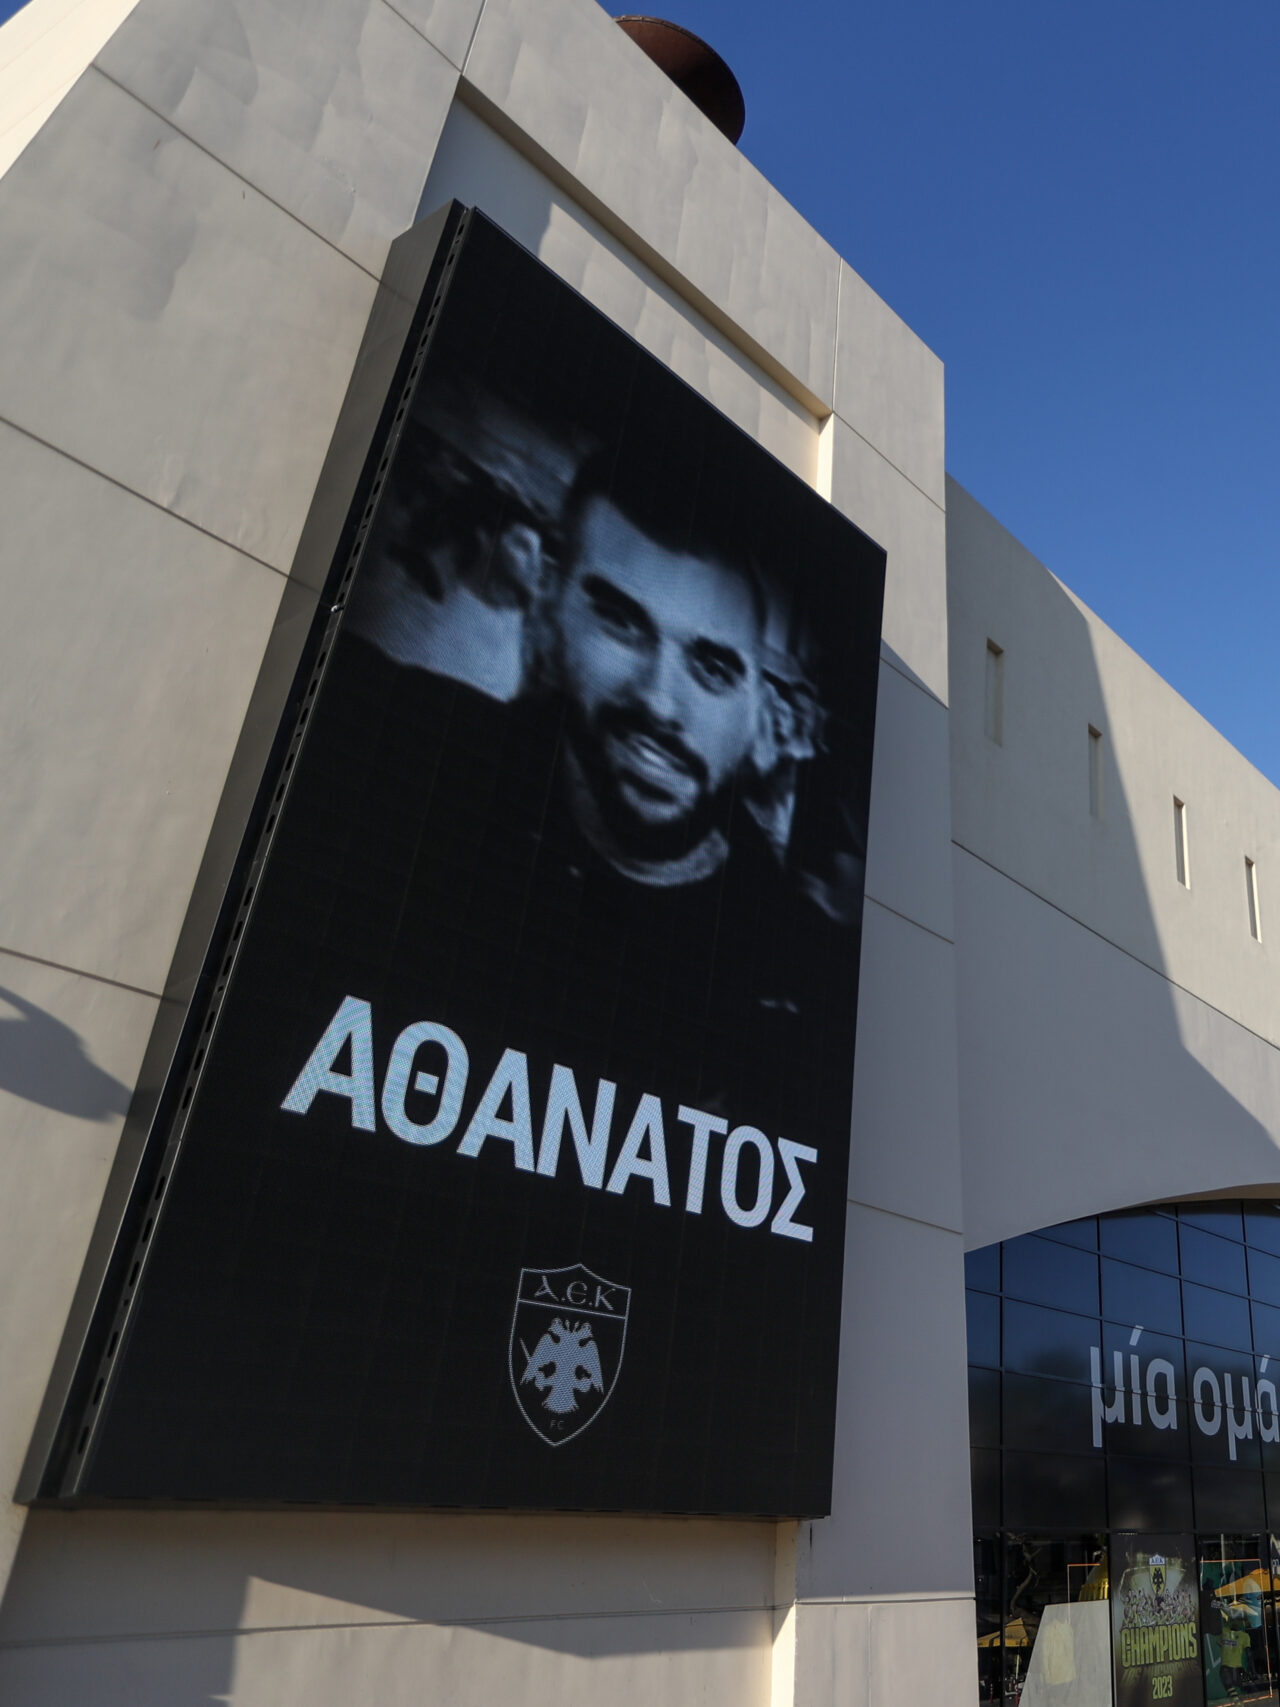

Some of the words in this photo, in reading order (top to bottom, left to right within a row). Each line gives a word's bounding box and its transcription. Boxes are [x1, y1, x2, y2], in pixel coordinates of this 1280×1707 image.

[280, 995, 818, 1242] ΑΘΑΝΑΤΟΣ
[1090, 1325, 1178, 1448] μία
[1120, 1622, 1198, 1668] CHAMPIONS
[1152, 1675, 1173, 1699] 2023
